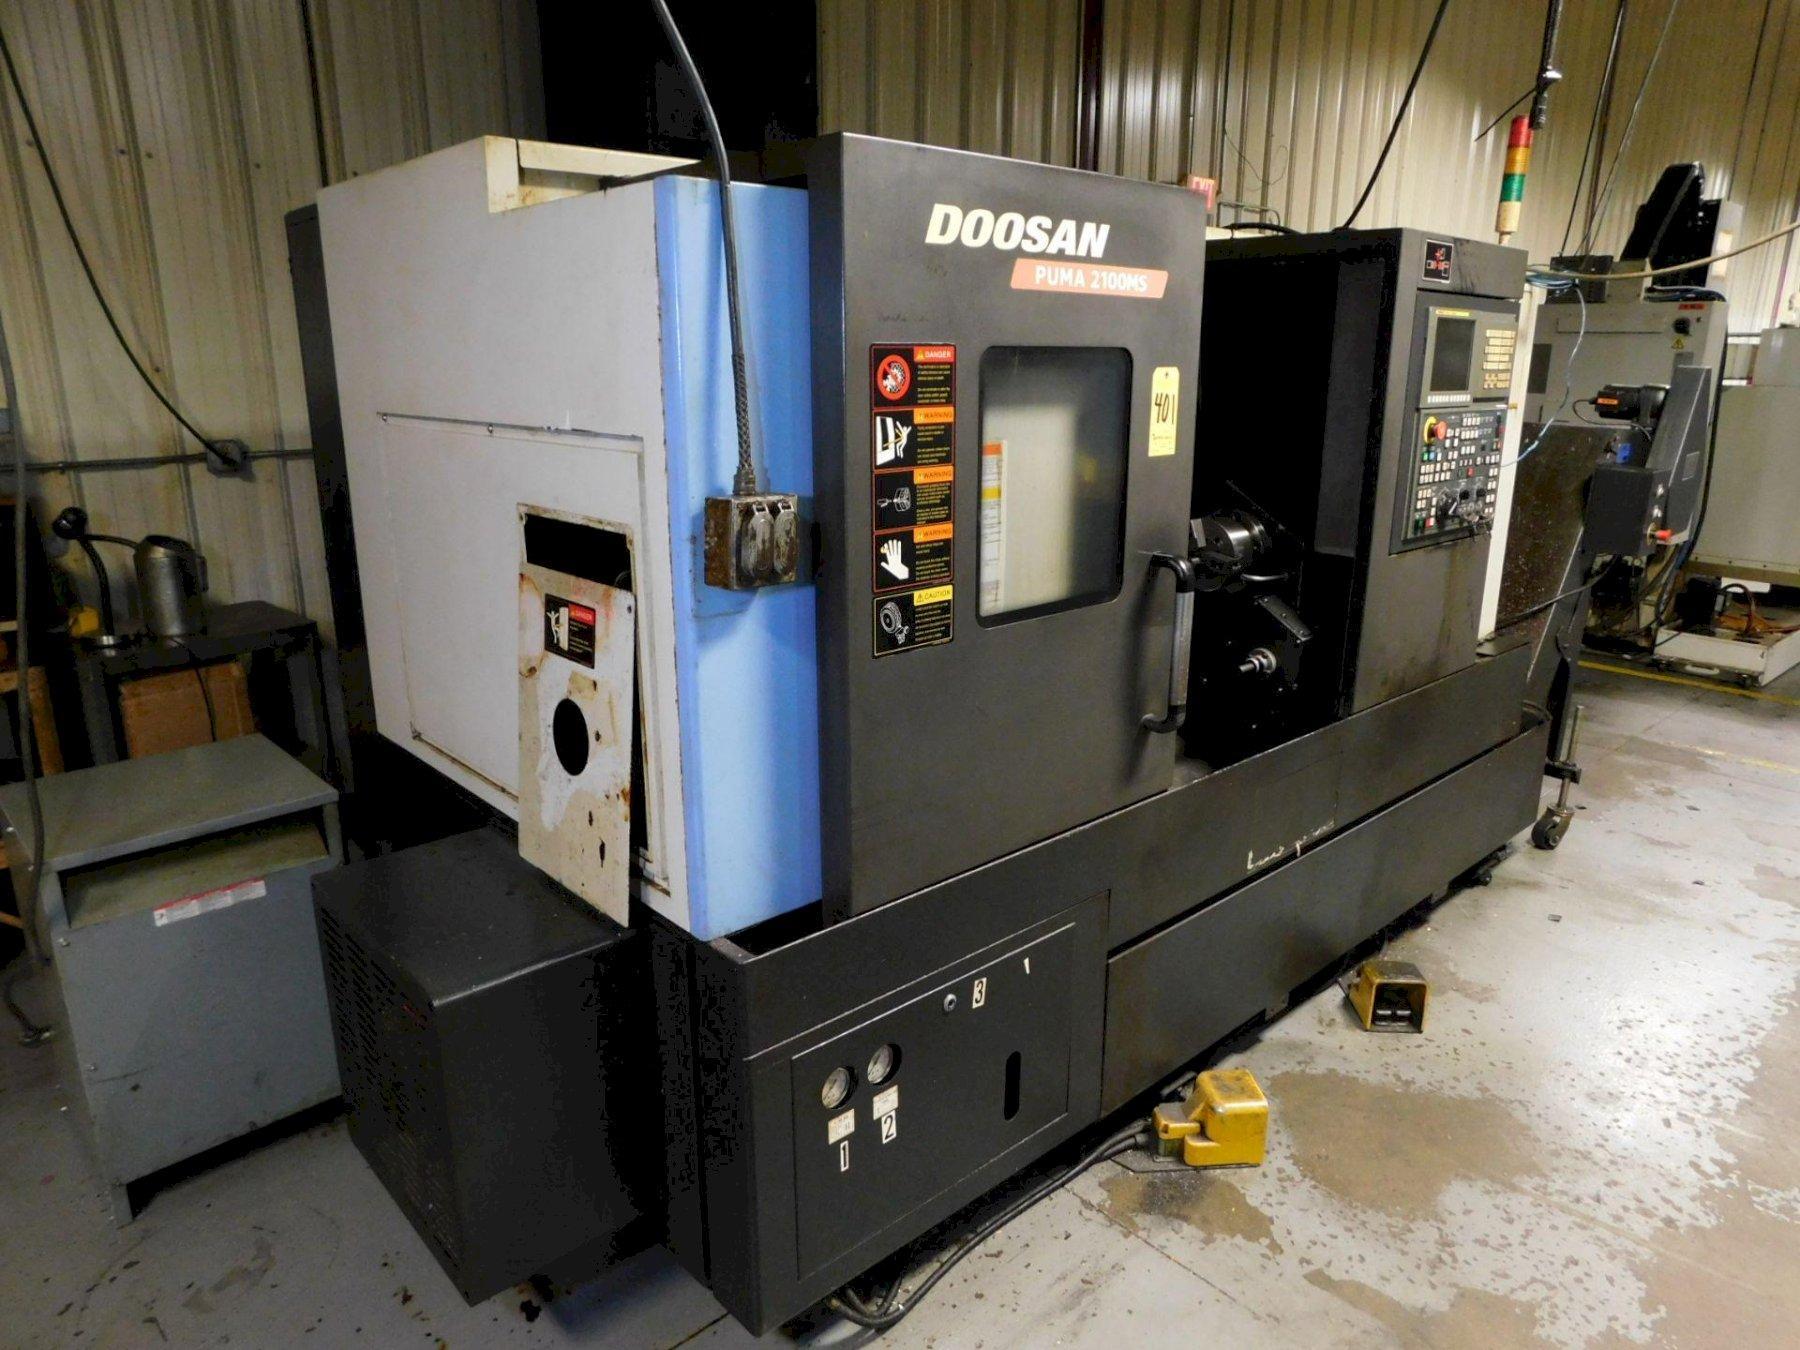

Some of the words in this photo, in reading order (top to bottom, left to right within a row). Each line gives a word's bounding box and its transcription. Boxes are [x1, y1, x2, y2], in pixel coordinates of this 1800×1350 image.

[924, 203, 1111, 259] DOOSAN
[1035, 265, 1085, 288] PUMA
[1090, 270, 1149, 293] 2100MS
[1154, 392, 1175, 425] 401
[924, 590, 951, 600] CAUTION
[975, 980, 984, 1004] 3
[883, 1114, 895, 1140] 2
[841, 1143, 848, 1169] 1
